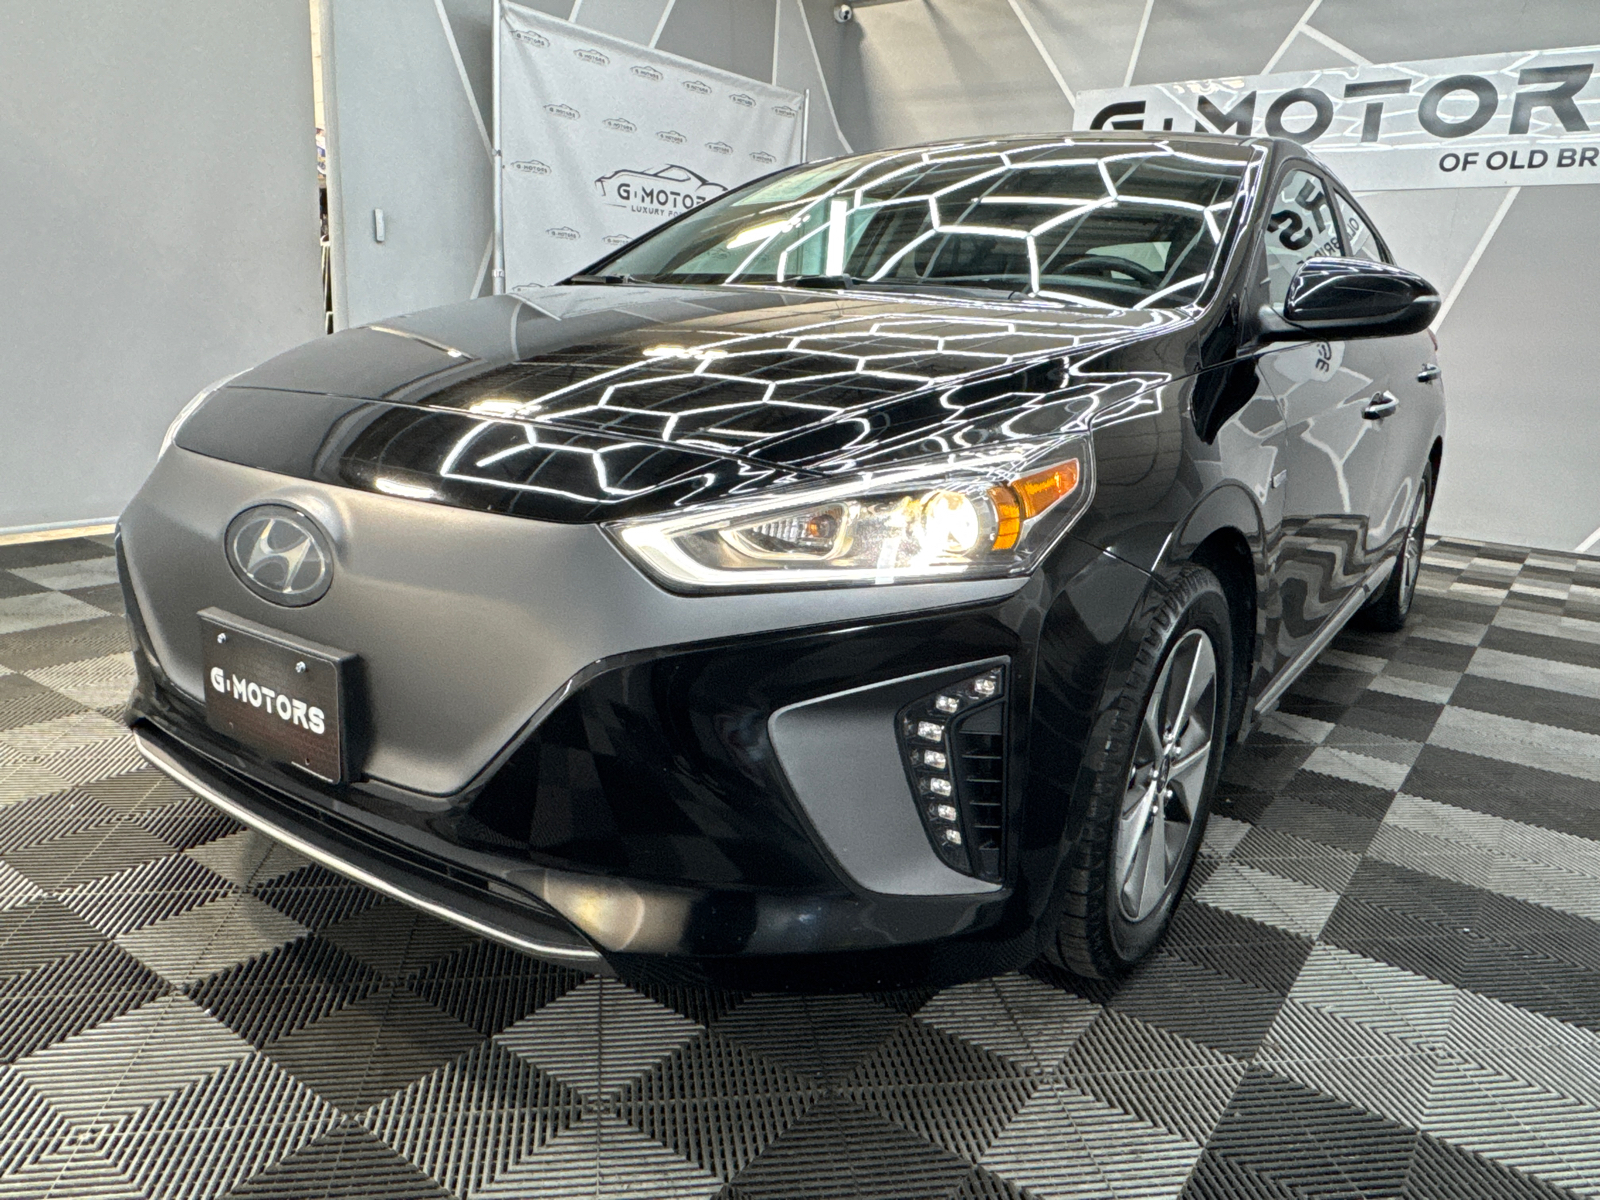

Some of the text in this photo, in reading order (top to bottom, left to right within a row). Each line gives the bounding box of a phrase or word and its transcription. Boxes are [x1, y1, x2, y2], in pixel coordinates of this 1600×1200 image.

[1439, 151, 1480, 172] OF
[1485, 149, 1549, 170] OLD
[631, 205, 665, 216] LUXURY
